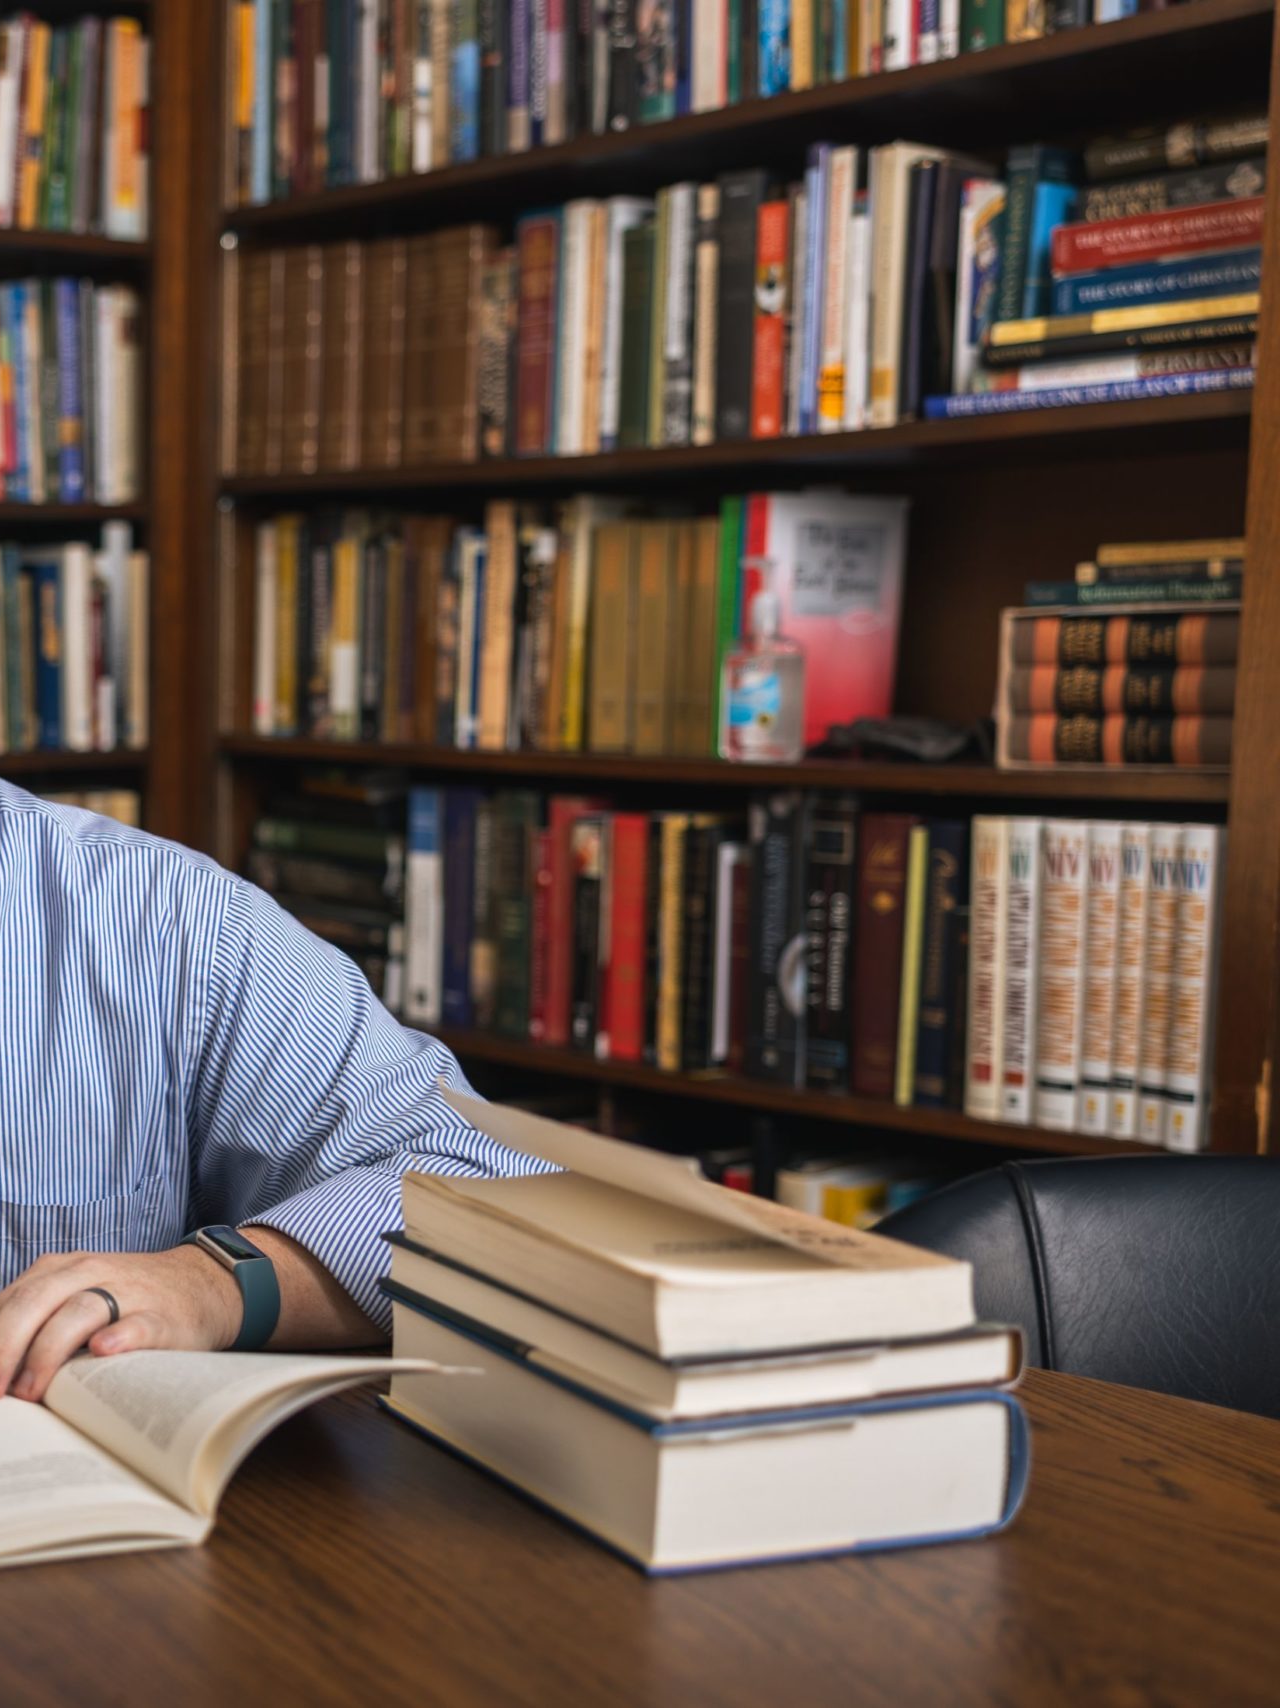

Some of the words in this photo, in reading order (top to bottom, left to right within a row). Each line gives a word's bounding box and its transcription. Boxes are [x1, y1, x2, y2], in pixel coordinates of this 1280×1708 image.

[1103, 225, 1151, 245] STORY
[1152, 221, 1173, 238] OF
[1173, 209, 1263, 233] CHRISTIANI
[1107, 279, 1154, 298] STORY
[1155, 275, 1176, 291] OF
[1177, 265, 1261, 289] CHRISTIAN
